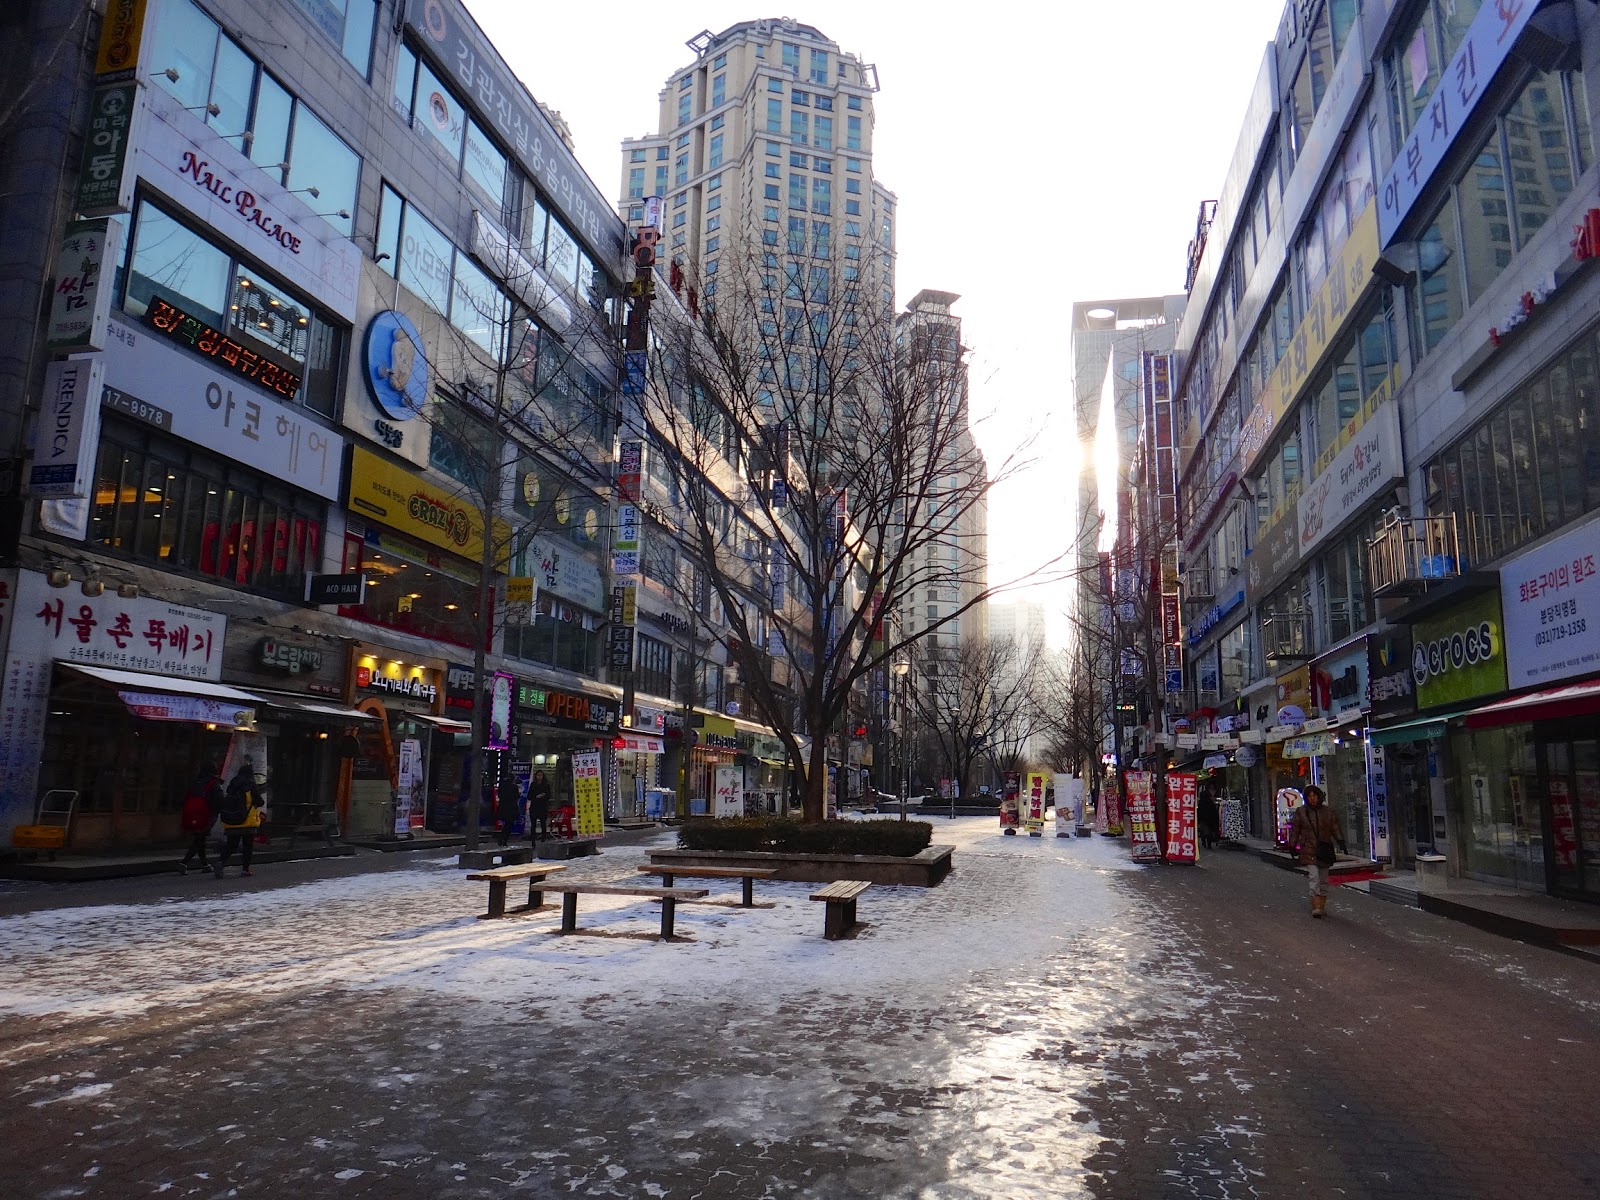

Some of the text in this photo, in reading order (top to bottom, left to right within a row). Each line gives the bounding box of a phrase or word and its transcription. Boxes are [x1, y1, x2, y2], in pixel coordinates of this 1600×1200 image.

[1384, 40, 1478, 218] 아부치킨
[405, 235, 449, 295] 아모레
[51, 369, 78, 459] TRENDICA
[623, 508, 635, 540] 더풋샵
[341, 583, 357, 593] HAIR
[1519, 554, 1596, 602] 화로구이의 원조
[262, 640, 321, 673] 보드람치킨
[1428, 620, 1497, 676] crocs
[1535, 618, 1587, 648] (031)719-1358
[545, 691, 590, 721] OPERA
[1181, 777, 1196, 857] 도와주세요
